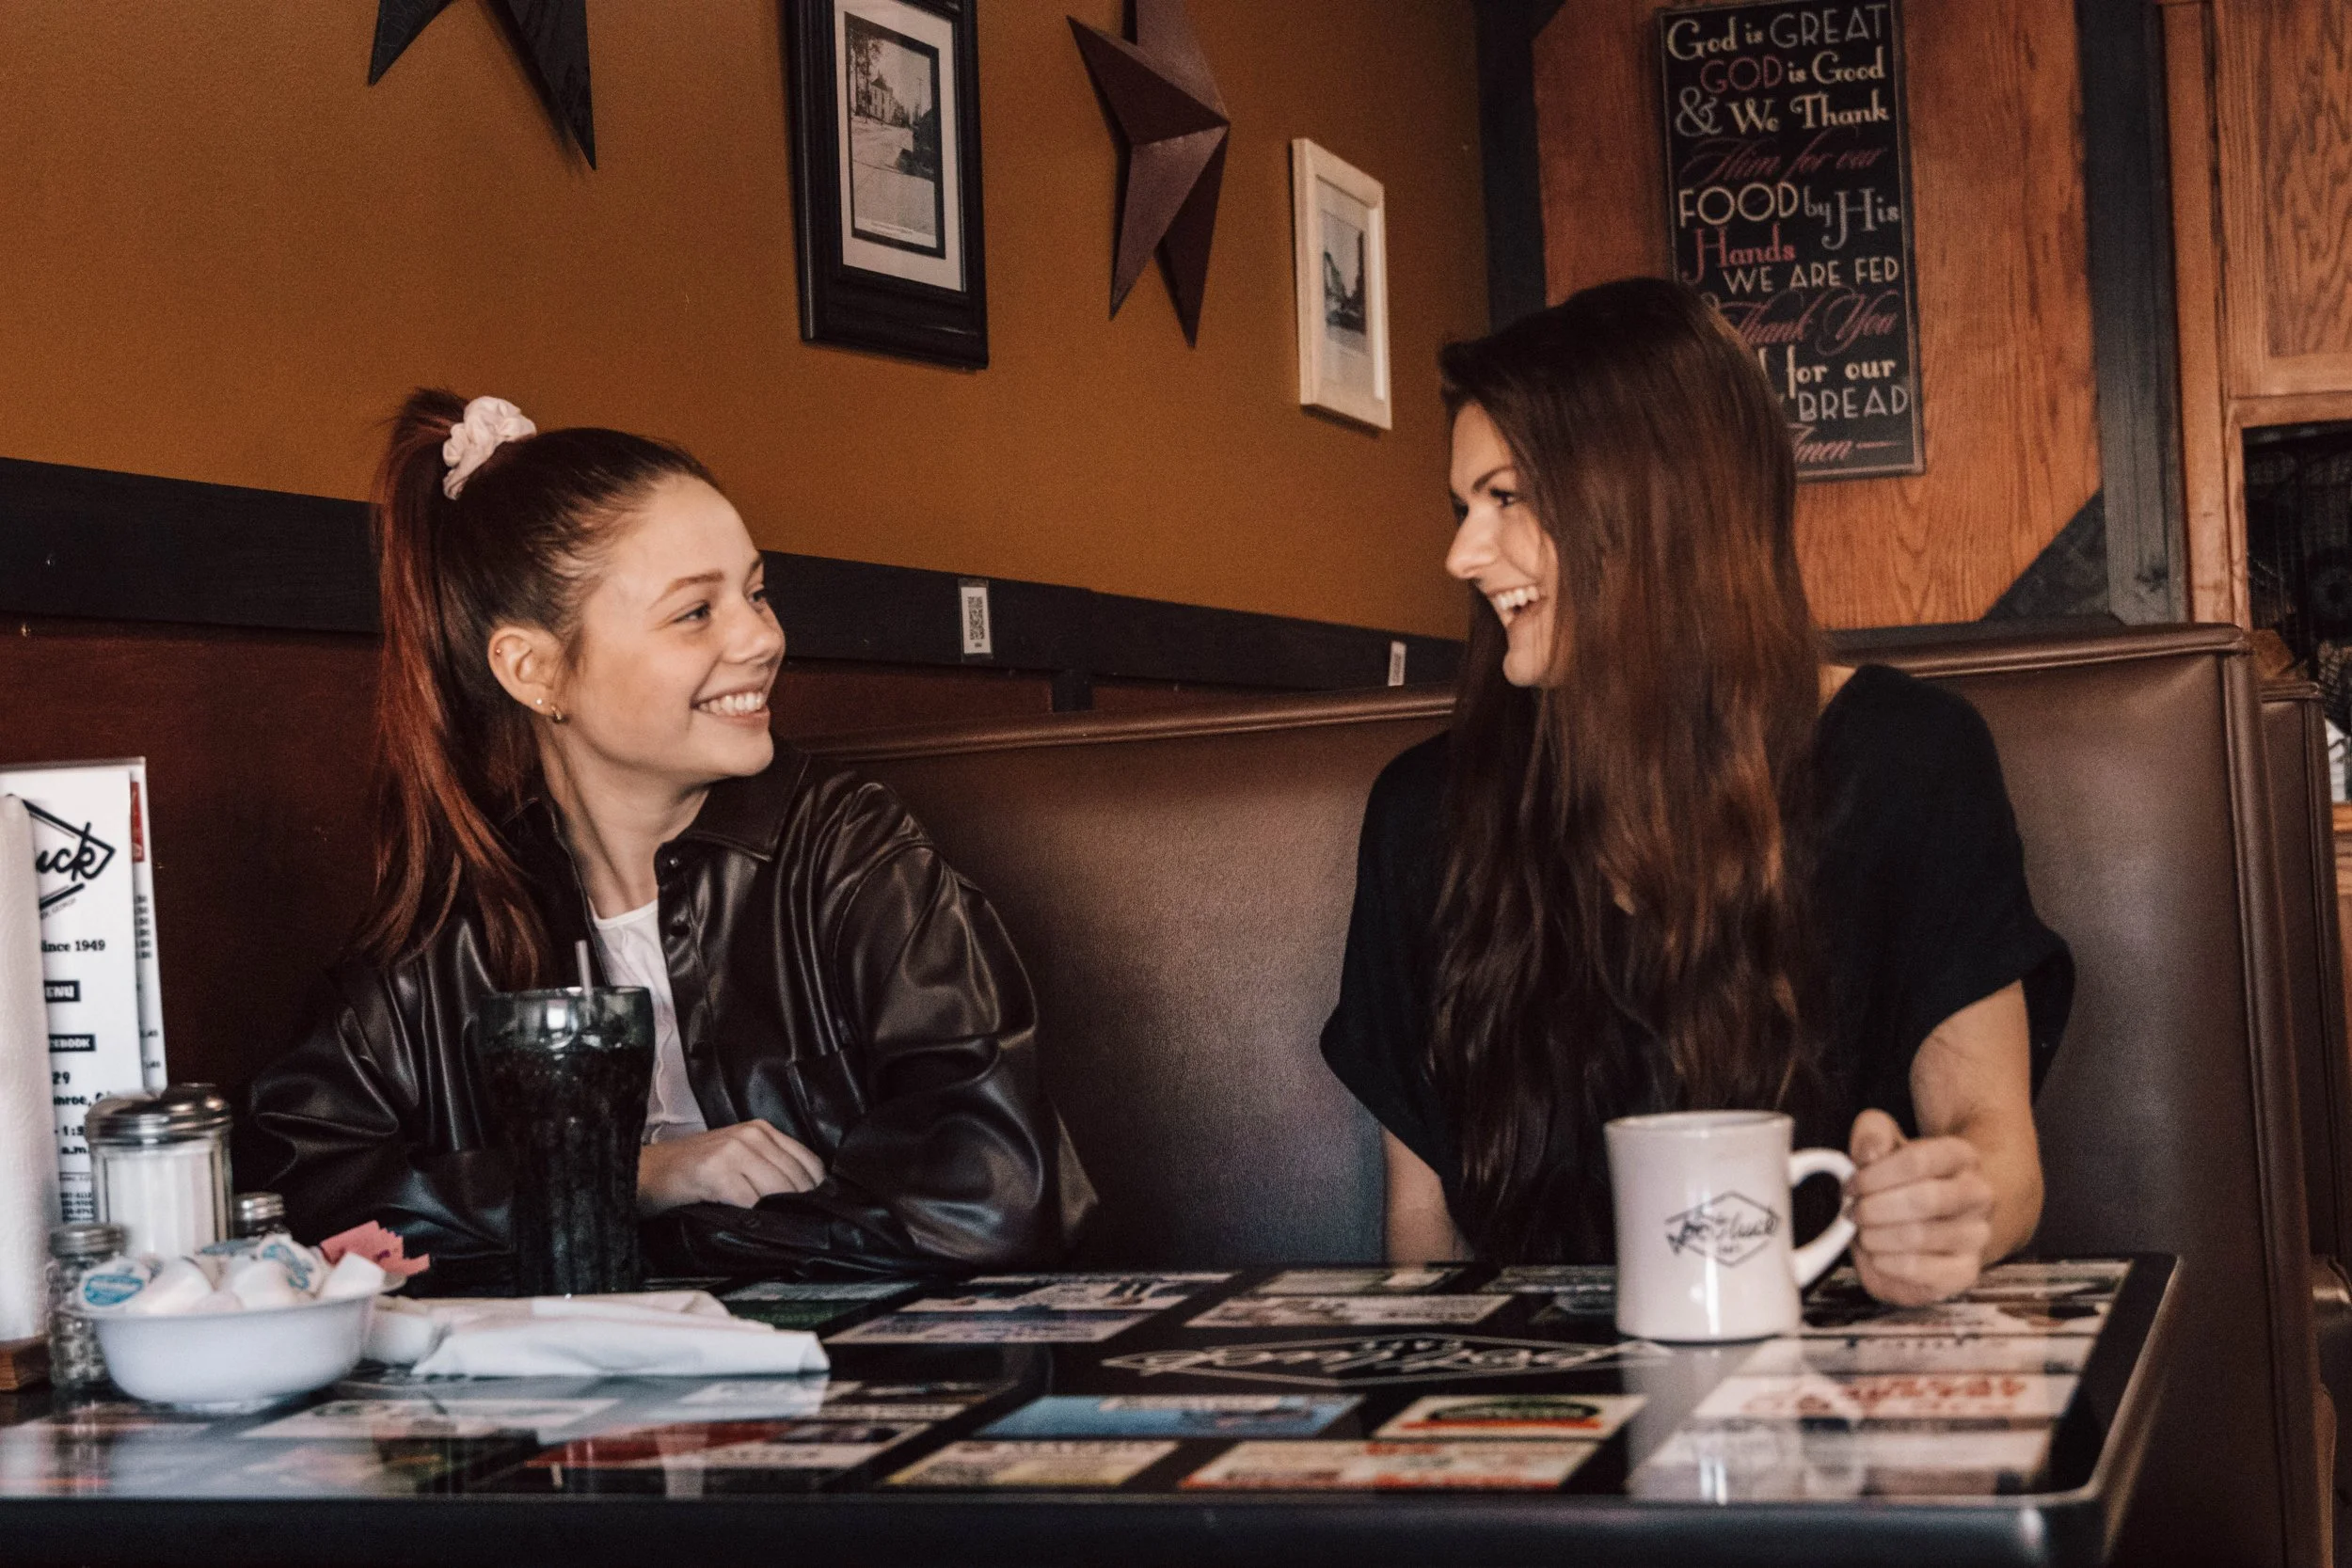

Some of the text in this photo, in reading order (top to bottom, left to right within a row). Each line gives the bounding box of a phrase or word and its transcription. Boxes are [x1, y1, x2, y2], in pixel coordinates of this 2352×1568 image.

[1667, 4, 1888, 61] God is GREAT
[1700, 45, 1886, 94] GOD is Good
[1726, 97, 1781, 135] We
[1789, 88, 1890, 130] Thank
[1678, 181, 1902, 250] FOOD by His
[1682, 222, 1796, 283] Hands
[1723, 256, 1901, 294] WE ARE FED
[1814, 287, 1900, 356] You
[1844, 358, 1898, 381] our
[1797, 384, 1909, 422] BREAD
[75, 940, 105, 952] 1949
